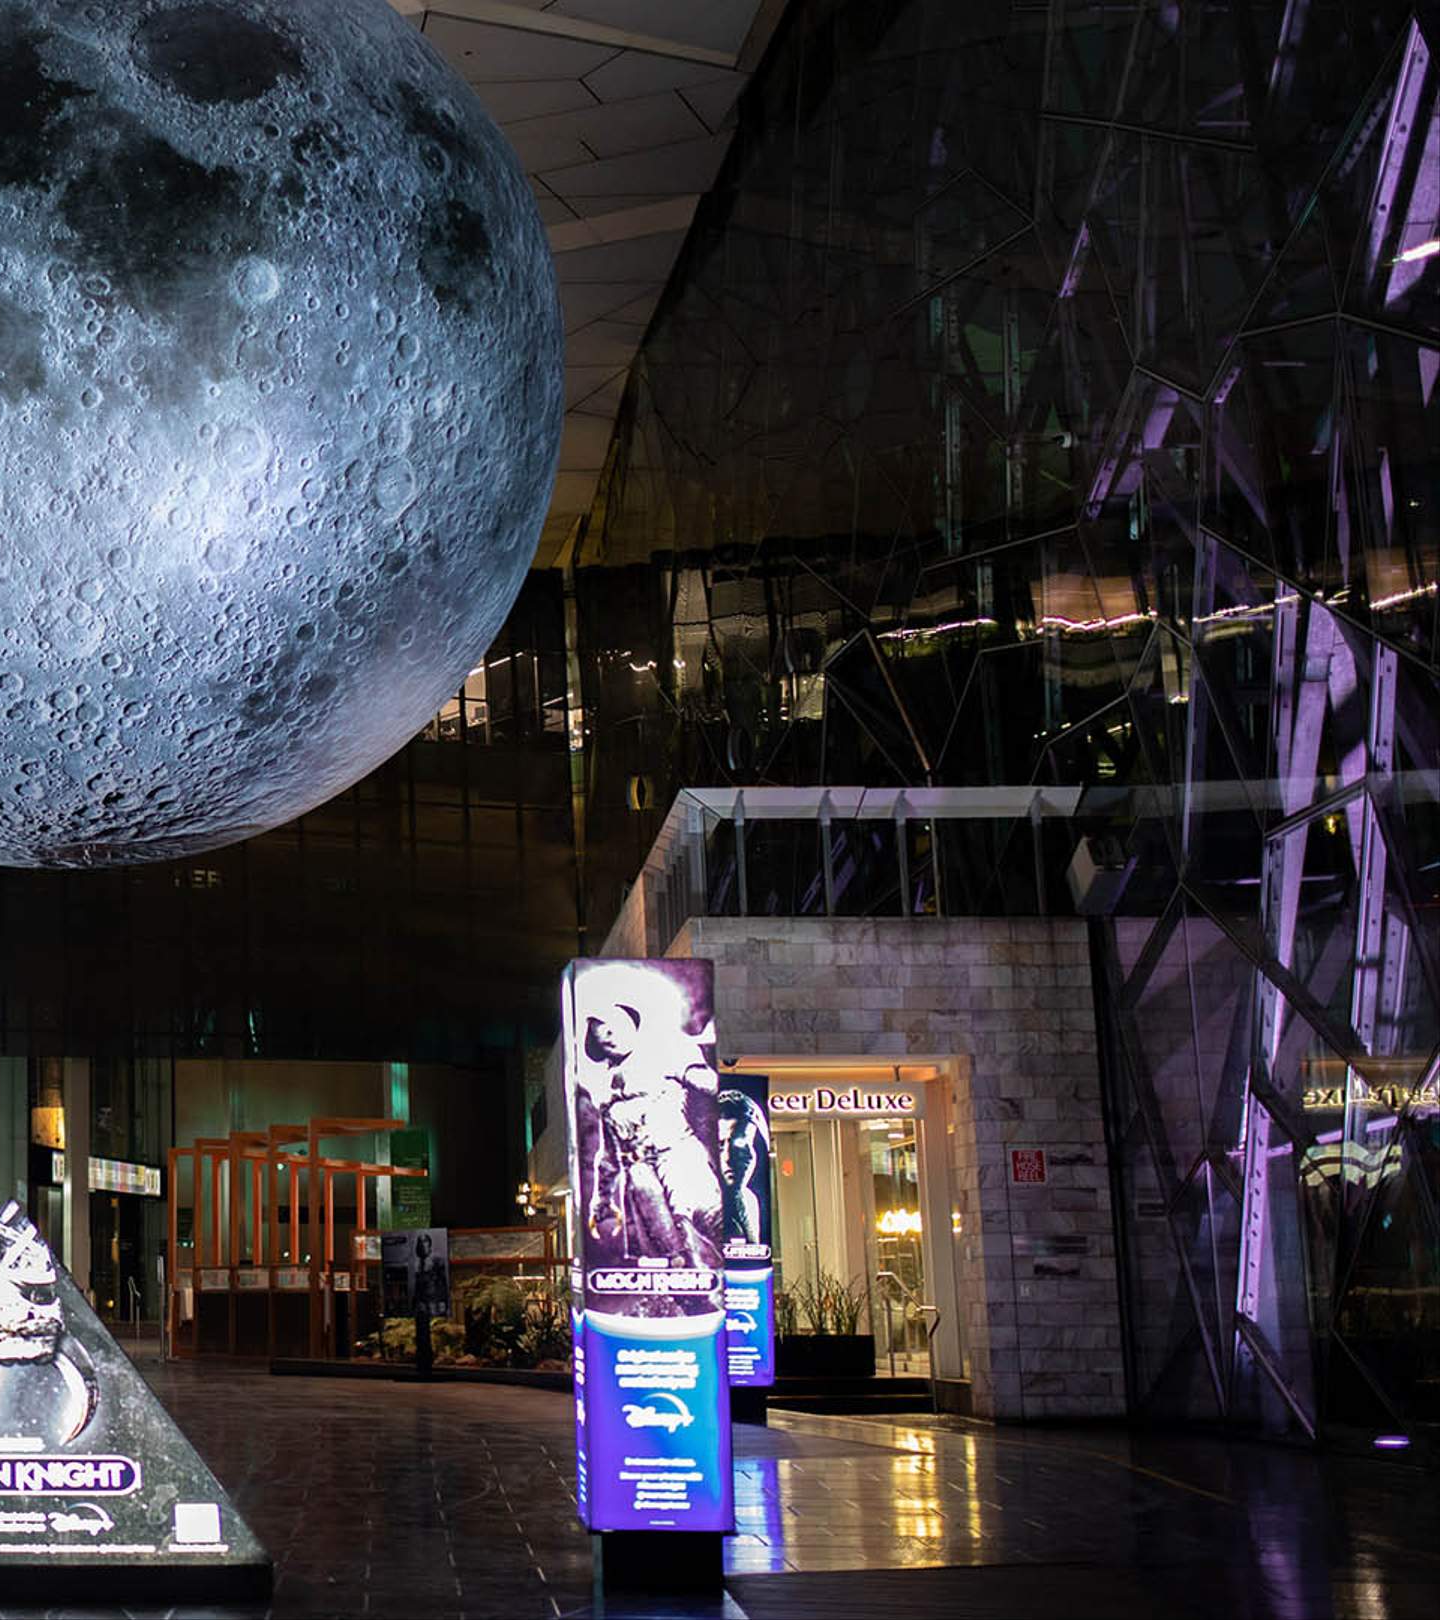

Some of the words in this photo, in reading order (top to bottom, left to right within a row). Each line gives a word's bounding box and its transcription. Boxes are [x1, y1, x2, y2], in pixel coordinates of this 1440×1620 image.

[769, 1094, 812, 1111] eer
[816, 1089, 913, 1111] DeLuxe
[1017, 1151, 1038, 1161] FIRE
[1016, 1160, 1042, 1172] HOSE
[1018, 1171, 1042, 1181] REEL
[596, 1272, 652, 1291] MOON
[652, 1272, 714, 1291] KNIGHT
[15, 1462, 125, 1490] KNIGHT
